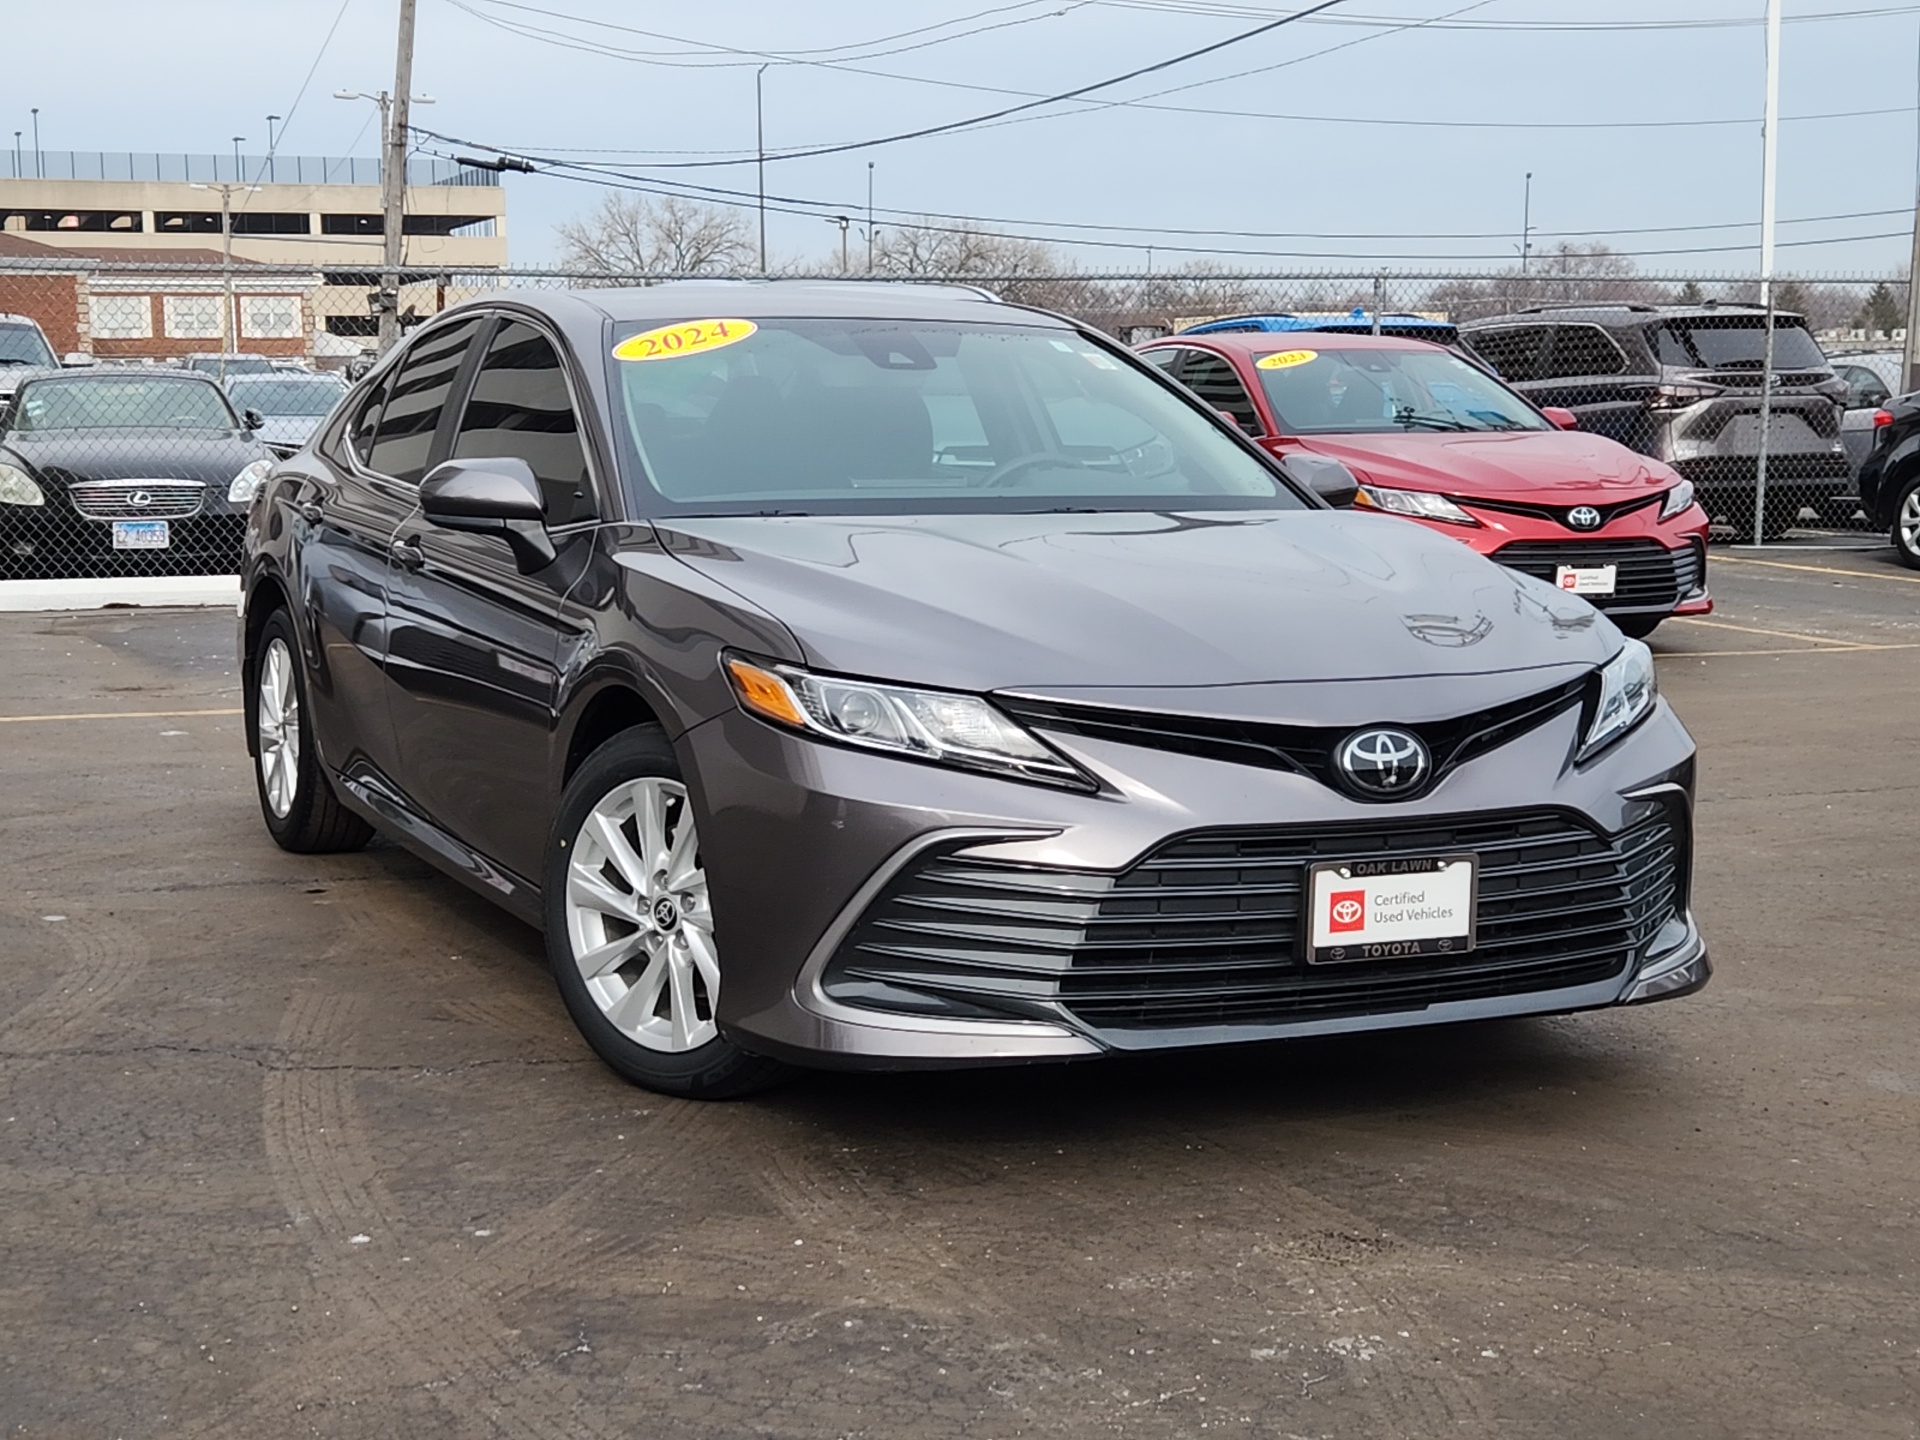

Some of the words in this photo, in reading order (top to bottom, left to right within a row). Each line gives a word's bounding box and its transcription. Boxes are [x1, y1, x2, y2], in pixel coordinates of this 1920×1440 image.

[639, 321, 730, 357] 2024
[1269, 352, 1306, 367] 2023
[1357, 862, 1387, 875] OAK
[1391, 859, 1433, 872] LAWN
[1374, 891, 1425, 906] Certified
[1374, 910, 1404, 923] Used
[1407, 907, 1453, 921] Vehicles
[1361, 942, 1421, 957] TOYOTA
